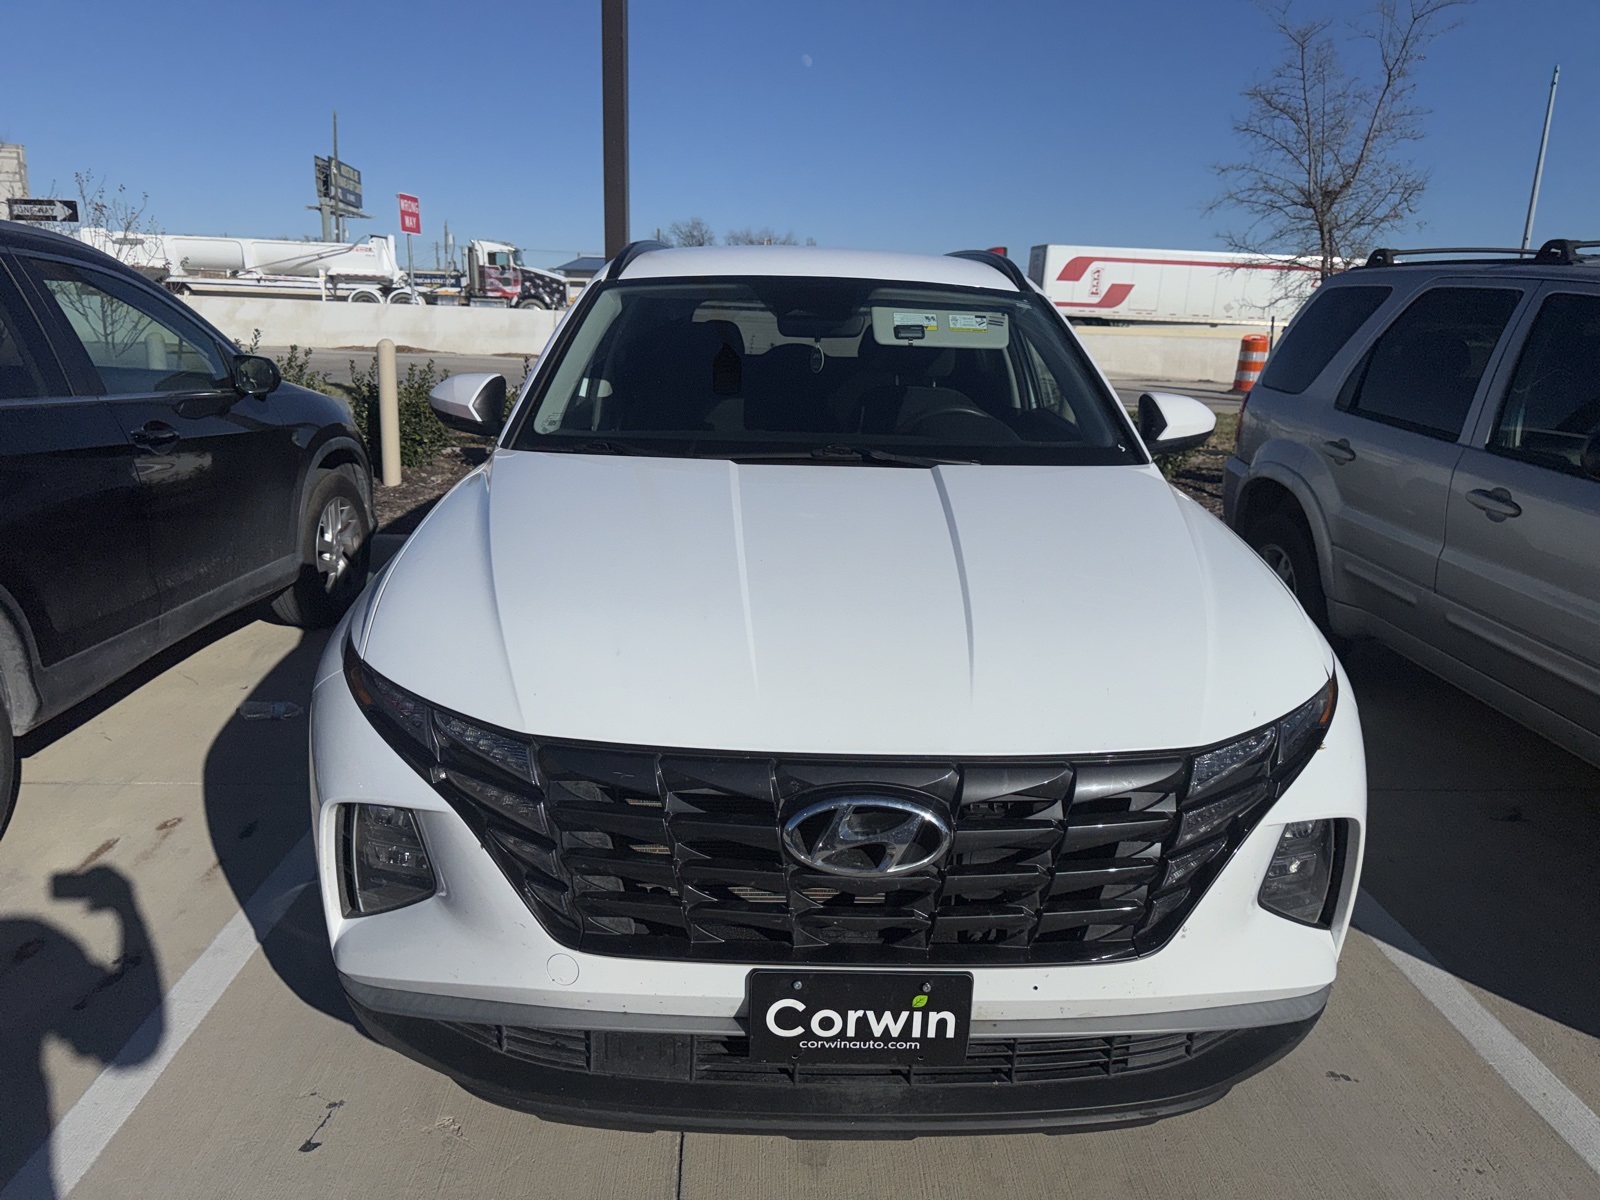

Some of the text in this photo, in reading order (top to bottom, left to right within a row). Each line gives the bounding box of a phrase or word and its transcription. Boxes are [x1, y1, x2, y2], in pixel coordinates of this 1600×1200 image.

[17, 205, 55, 214] ONE WAY
[400, 199, 419, 214] WRONG
[404, 215, 417, 229] WAY
[765, 994, 957, 1039] Corwin
[799, 1038, 921, 1050] corwinauto.com
